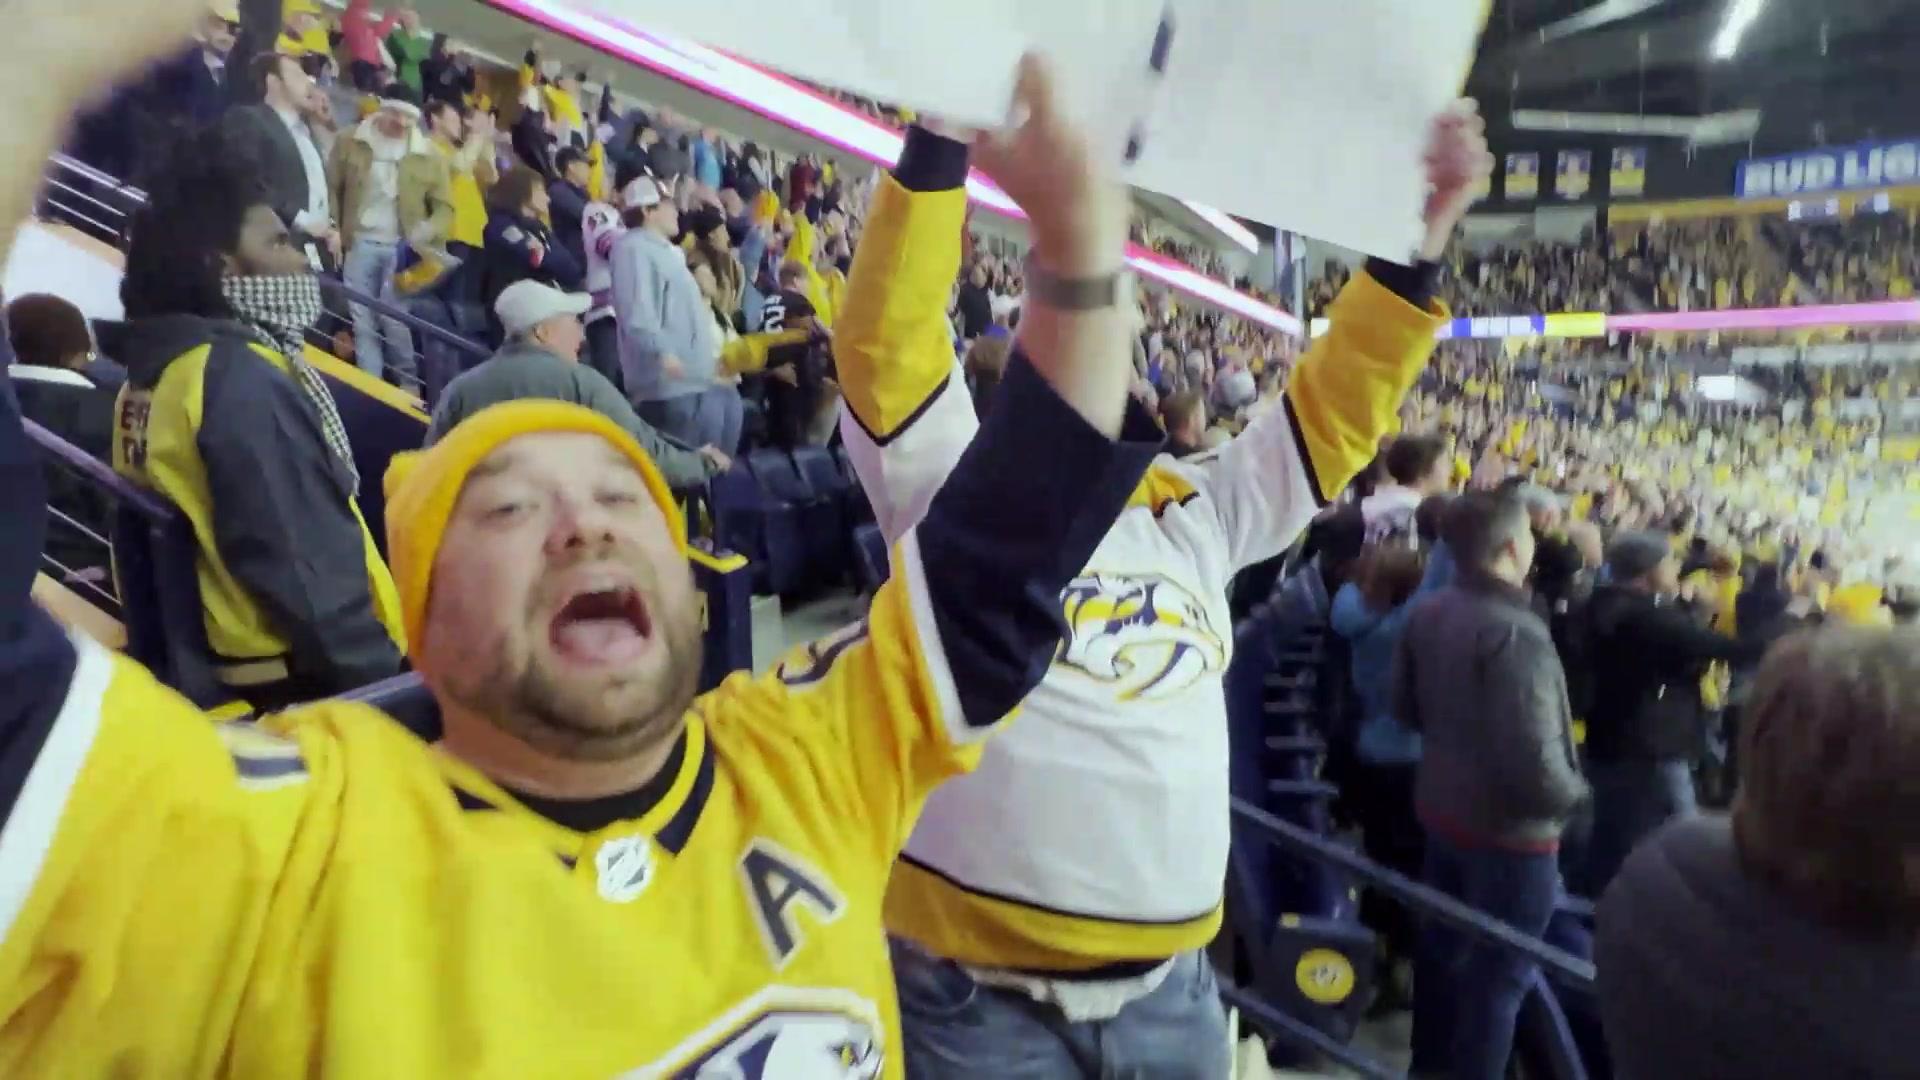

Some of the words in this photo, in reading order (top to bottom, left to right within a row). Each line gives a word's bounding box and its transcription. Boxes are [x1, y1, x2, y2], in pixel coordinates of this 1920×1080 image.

[1744, 154, 1837, 198] BUD
[1843, 143, 1920, 186] LIG
[741, 843, 842, 964] A
